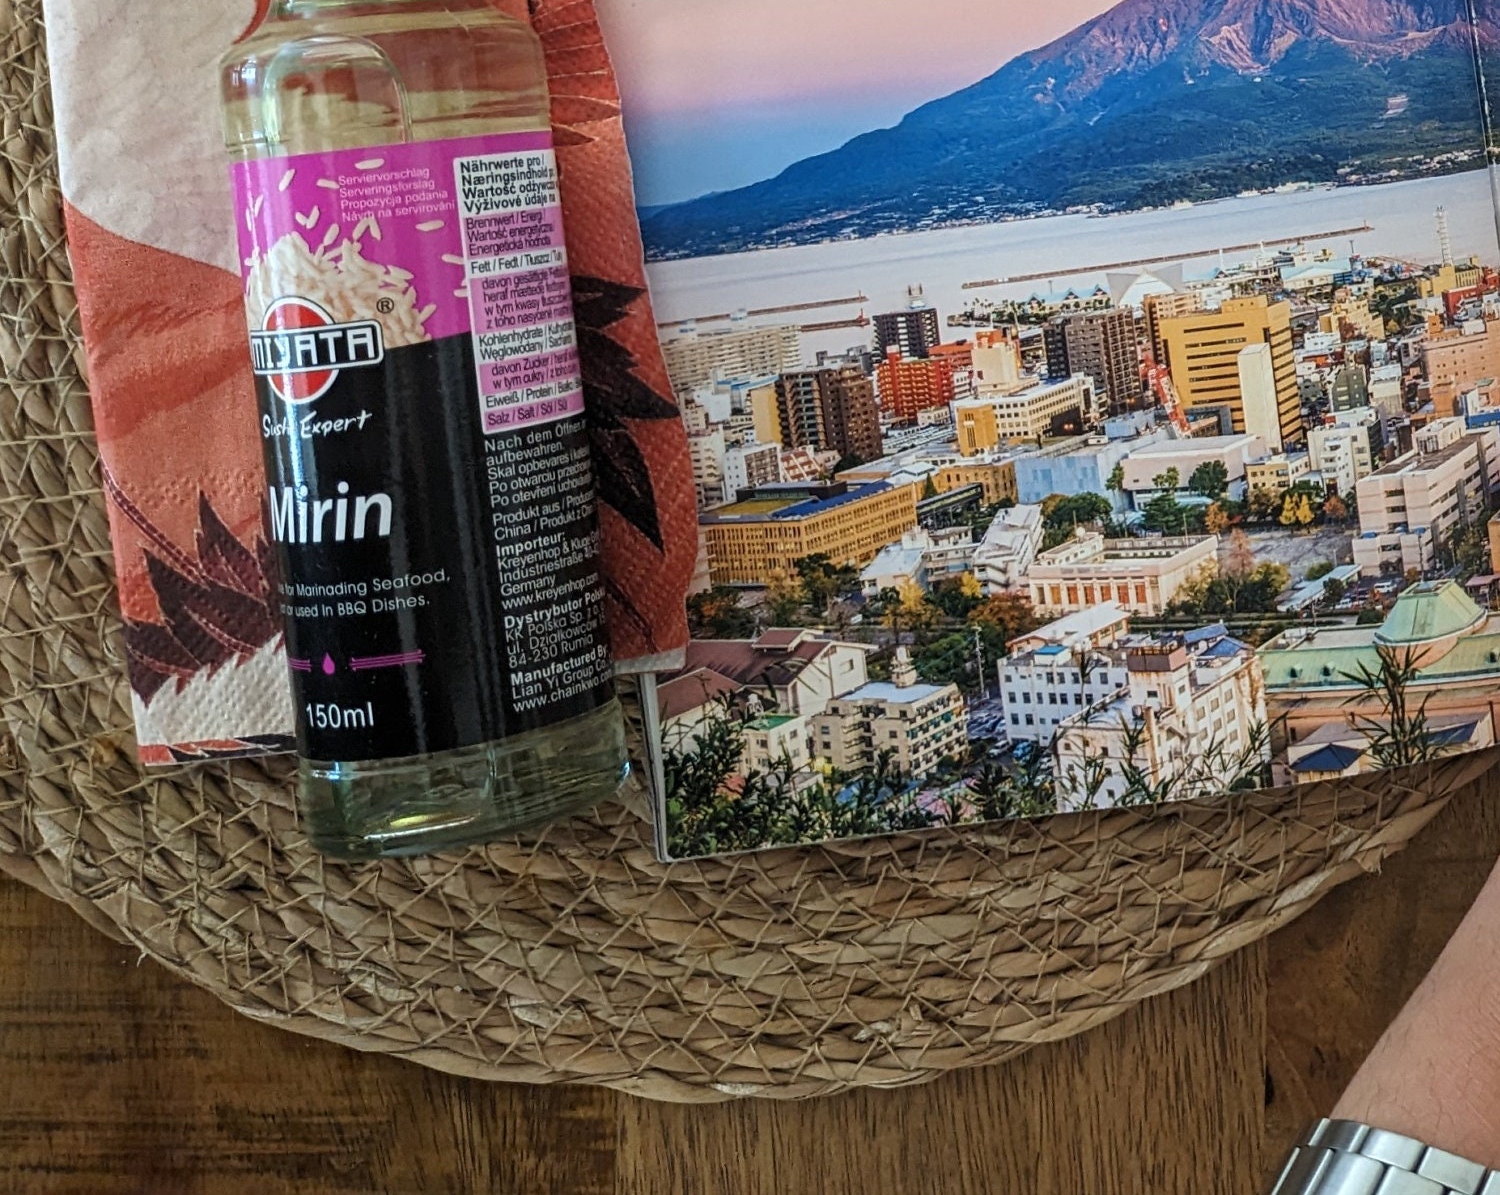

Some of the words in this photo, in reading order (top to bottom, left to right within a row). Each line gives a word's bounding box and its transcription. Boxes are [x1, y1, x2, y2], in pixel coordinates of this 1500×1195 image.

[338, 167, 430, 186] Serviervorschlag
[460, 157, 524, 173] Nährwerte
[527, 157, 540, 169] pro
[340, 194, 402, 211] Propozycja
[405, 190, 448, 207] podania
[462, 184, 516, 199] Wartość
[378, 208, 392, 219] na
[464, 197, 521, 214] Výživové
[525, 193, 547, 206] údaje
[465, 215, 514, 230] Brennwert
[471, 259, 491, 274] Fett
[498, 255, 518, 270] Fedt
[482, 276, 512, 290] davon
[483, 288, 508, 303] heraf
[495, 314, 515, 327] toho
[496, 302, 514, 317] tym
[479, 326, 543, 347] Kohlenhydrate
[491, 362, 521, 376] davon
[504, 375, 522, 390] tym
[486, 391, 519, 408] Eiweiß
[526, 385, 553, 400] Protein
[262, 414, 292, 438] Sush
[300, 410, 372, 439] Expert
[488, 412, 510, 426] Salz
[517, 406, 535, 421] Salt
[485, 434, 522, 452] Nach
[526, 429, 552, 444] dem
[486, 441, 565, 466] aufbewahren.
[488, 464, 516, 480] Skal
[518, 453, 569, 475] opbevares
[490, 480, 508, 494] Po
[511, 470, 556, 490] otwarciu
[269, 481, 393, 543] Mirin
[491, 495, 509, 508] Po
[493, 505, 540, 526] Produkt
[542, 502, 560, 515] aus
[494, 523, 531, 540] China
[540, 509, 575, 530] Produkt
[496, 532, 565, 557] Importeur:
[498, 547, 560, 570] Kreyenhop
[500, 552, 583, 583] Industriestraße
[297, 582, 367, 597] Marinading
[373, 568, 451, 592] Seafood,
[501, 574, 556, 596] Germany
[295, 603, 319, 617] used
[338, 600, 367, 616] BBQ
[372, 594, 430, 613] Dishes.
[504, 597, 583, 630] Dystrybutor
[505, 628, 524, 643] KK
[528, 617, 567, 636] Polska
[507, 640, 524, 655] ul.
[509, 644, 558, 669] 84-230
[561, 634, 594, 654] Rumia
[511, 648, 596, 686] Manufactured
[512, 682, 543, 700] Lian
[546, 675, 559, 689] Yi
[562, 664, 594, 684] Group
[306, 701, 374, 728] 150ml
